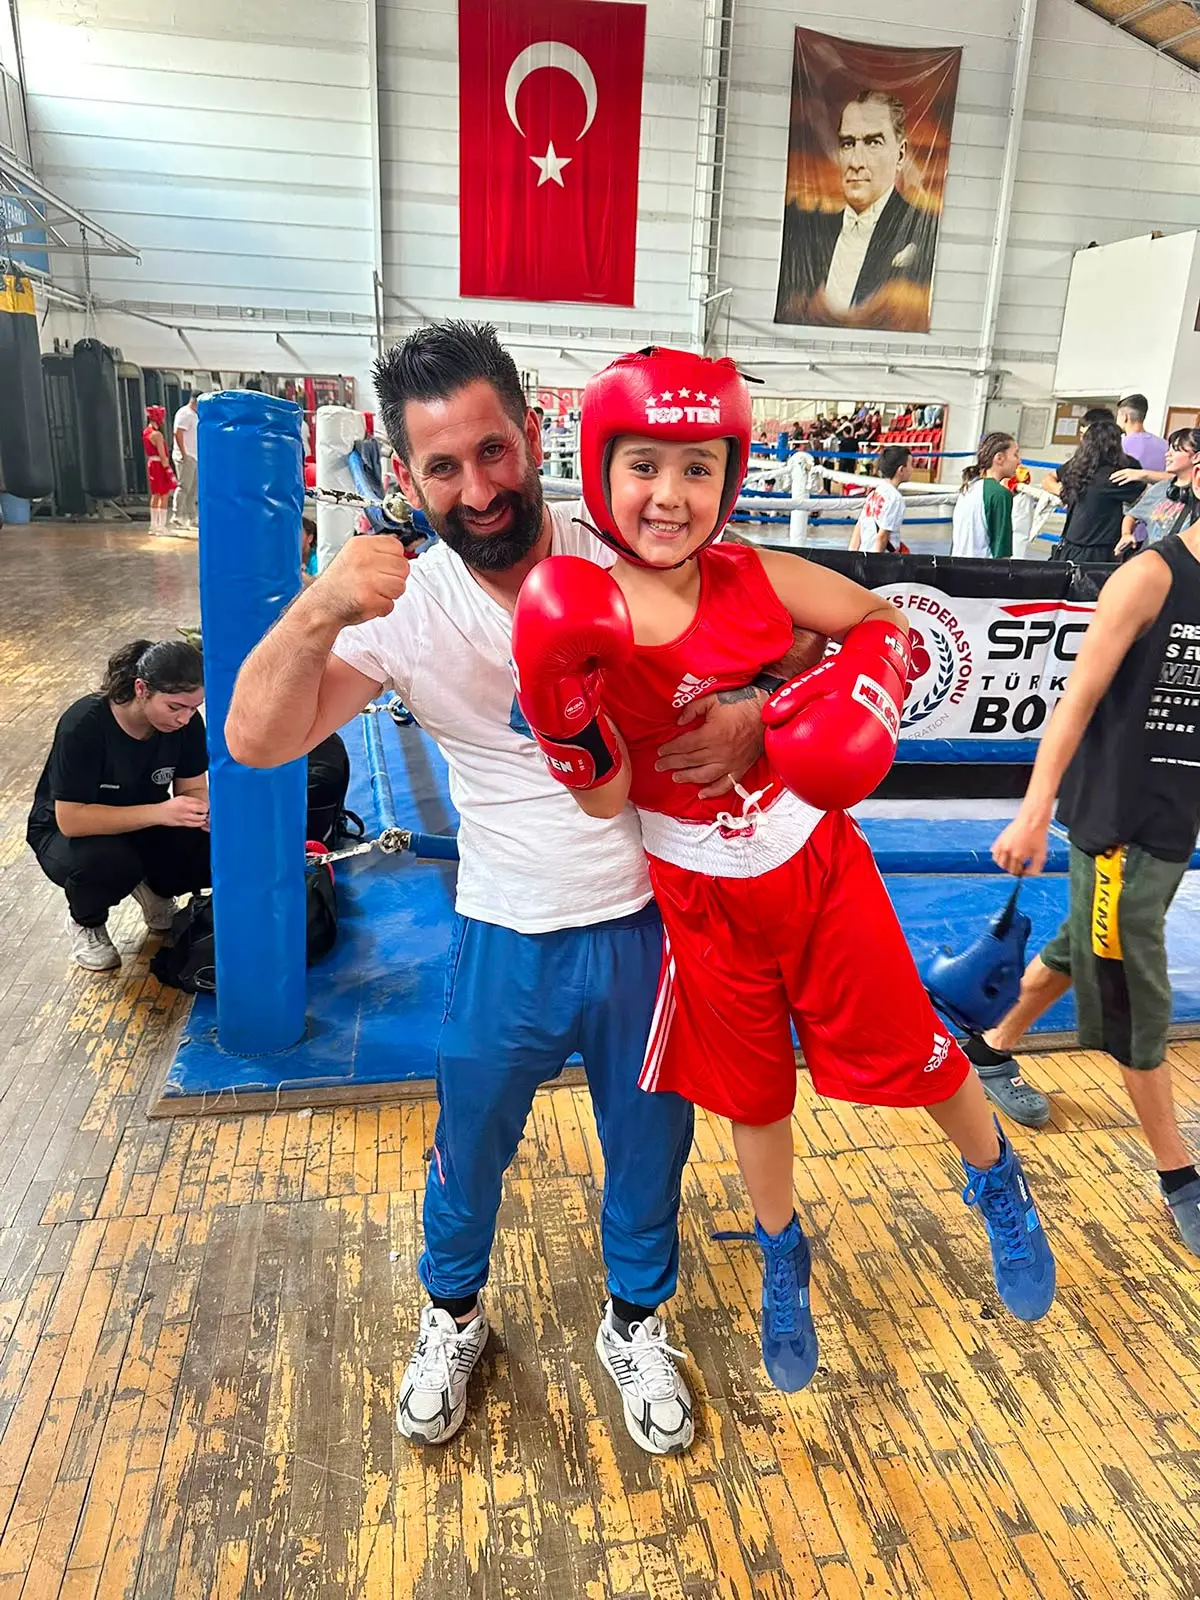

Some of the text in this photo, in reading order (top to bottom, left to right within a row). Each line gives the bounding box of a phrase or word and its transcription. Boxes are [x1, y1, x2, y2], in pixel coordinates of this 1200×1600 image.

[645, 406, 721, 425] TOP TEN
[908, 595, 972, 705] FEDERASYONU
[671, 676, 718, 708] adidas
[859, 683, 887, 712] TEN
[970, 694, 1061, 733] BO
[1096, 868, 1111, 949] ARMY
[923, 1037, 952, 1073] adidas
